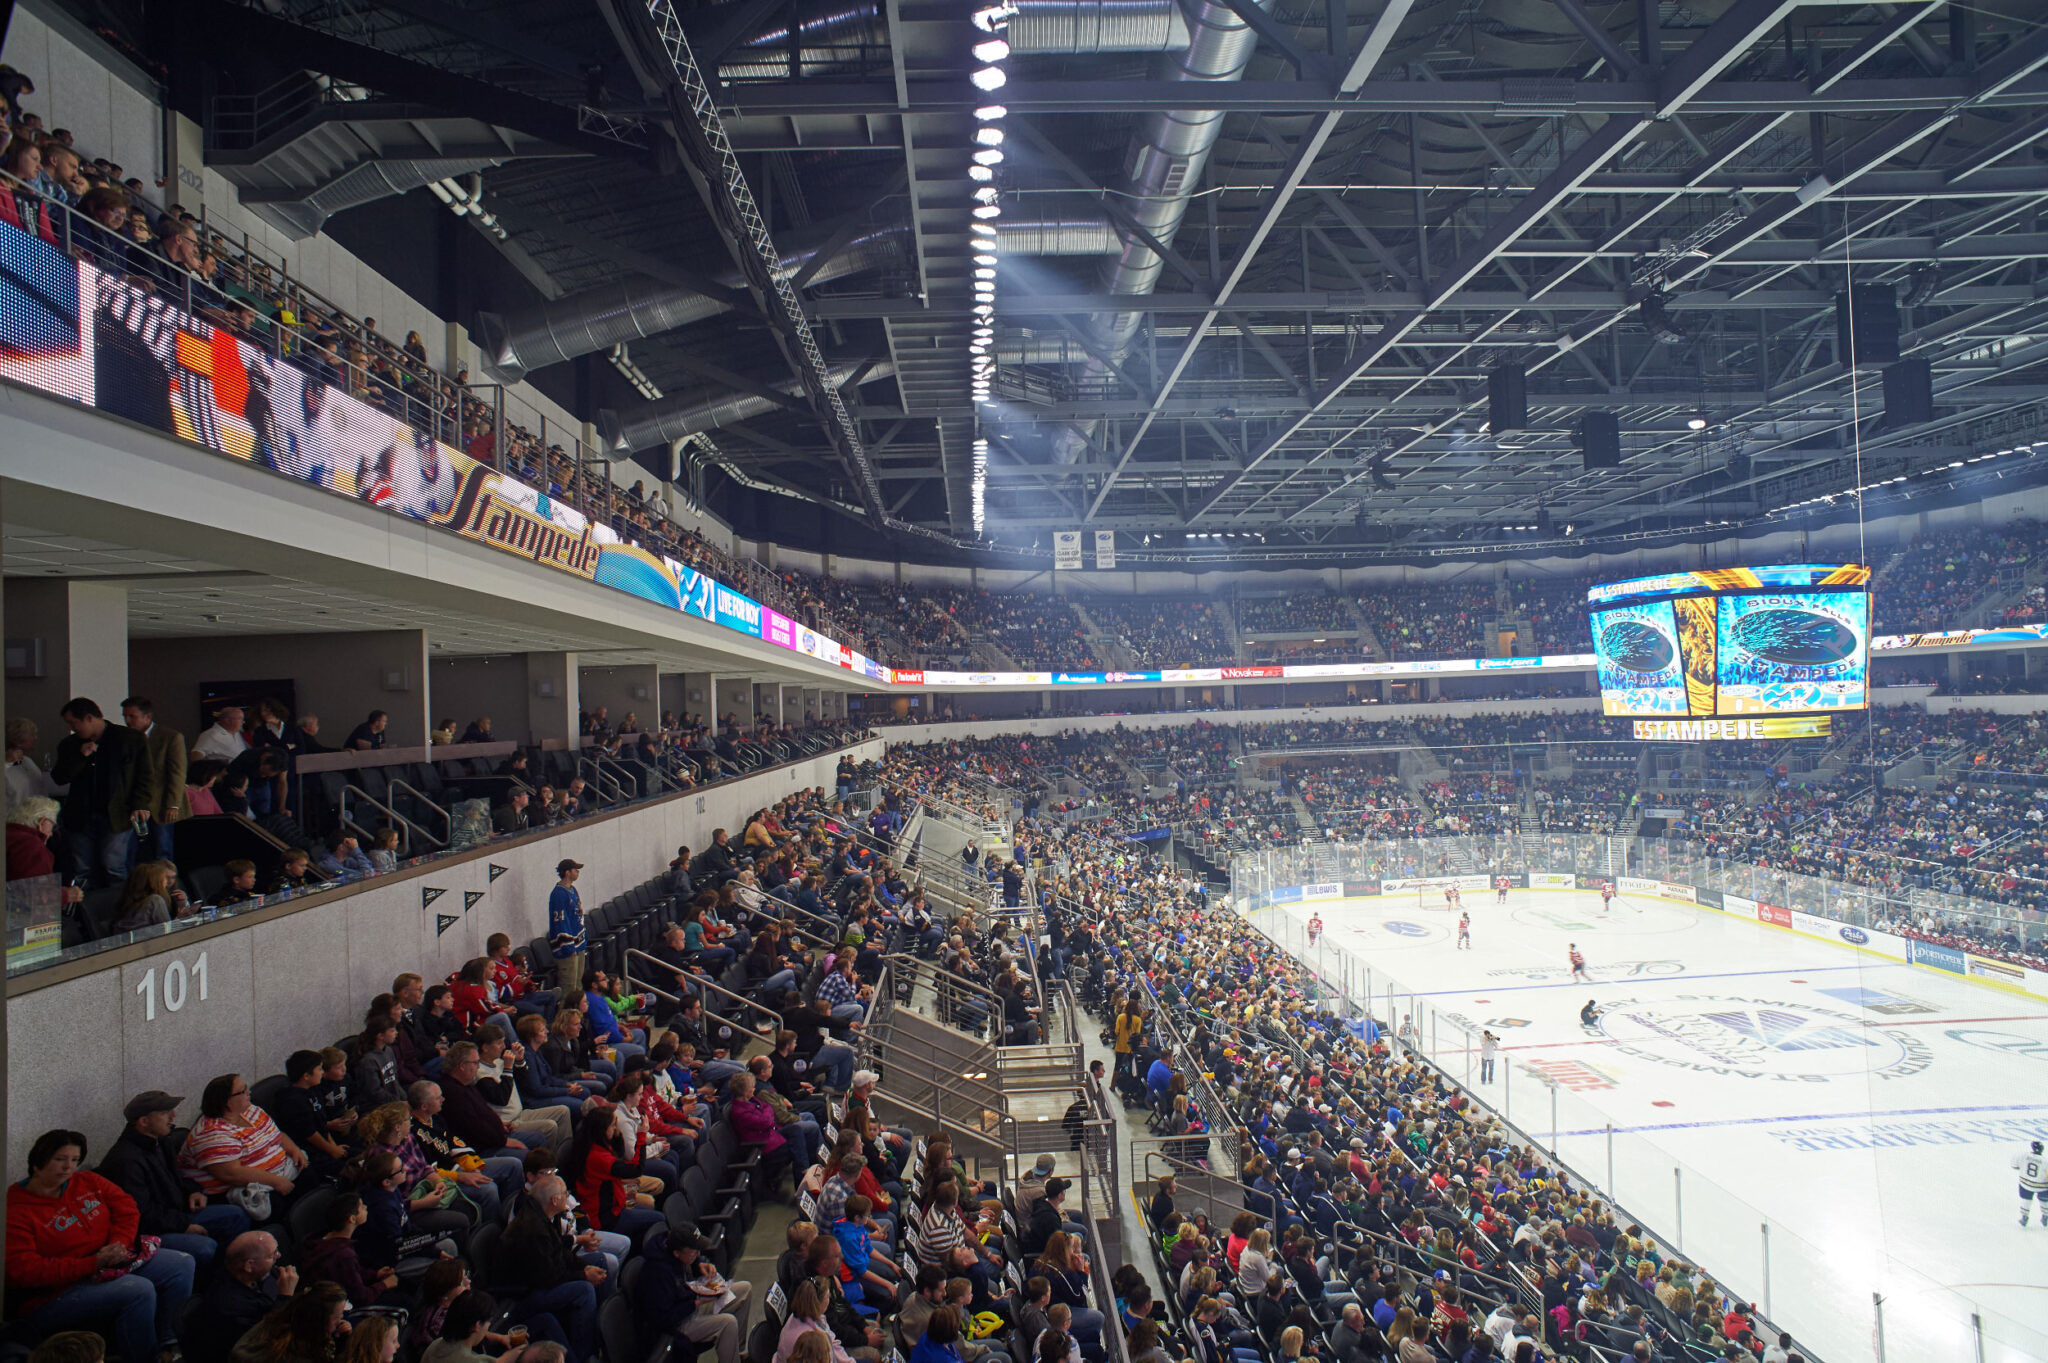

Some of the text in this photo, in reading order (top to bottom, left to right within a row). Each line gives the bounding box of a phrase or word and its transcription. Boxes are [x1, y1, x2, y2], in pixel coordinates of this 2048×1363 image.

[432, 466, 600, 575] Stampede
[1604, 611, 1637, 621] SIOUX
[1747, 597, 1852, 625] SIOUX FALLS
[1734, 654, 1857, 679] STAMPEDE
[553, 910, 565, 922] 24
[136, 951, 208, 1022] 101
[2026, 1162, 2039, 1177] 8
